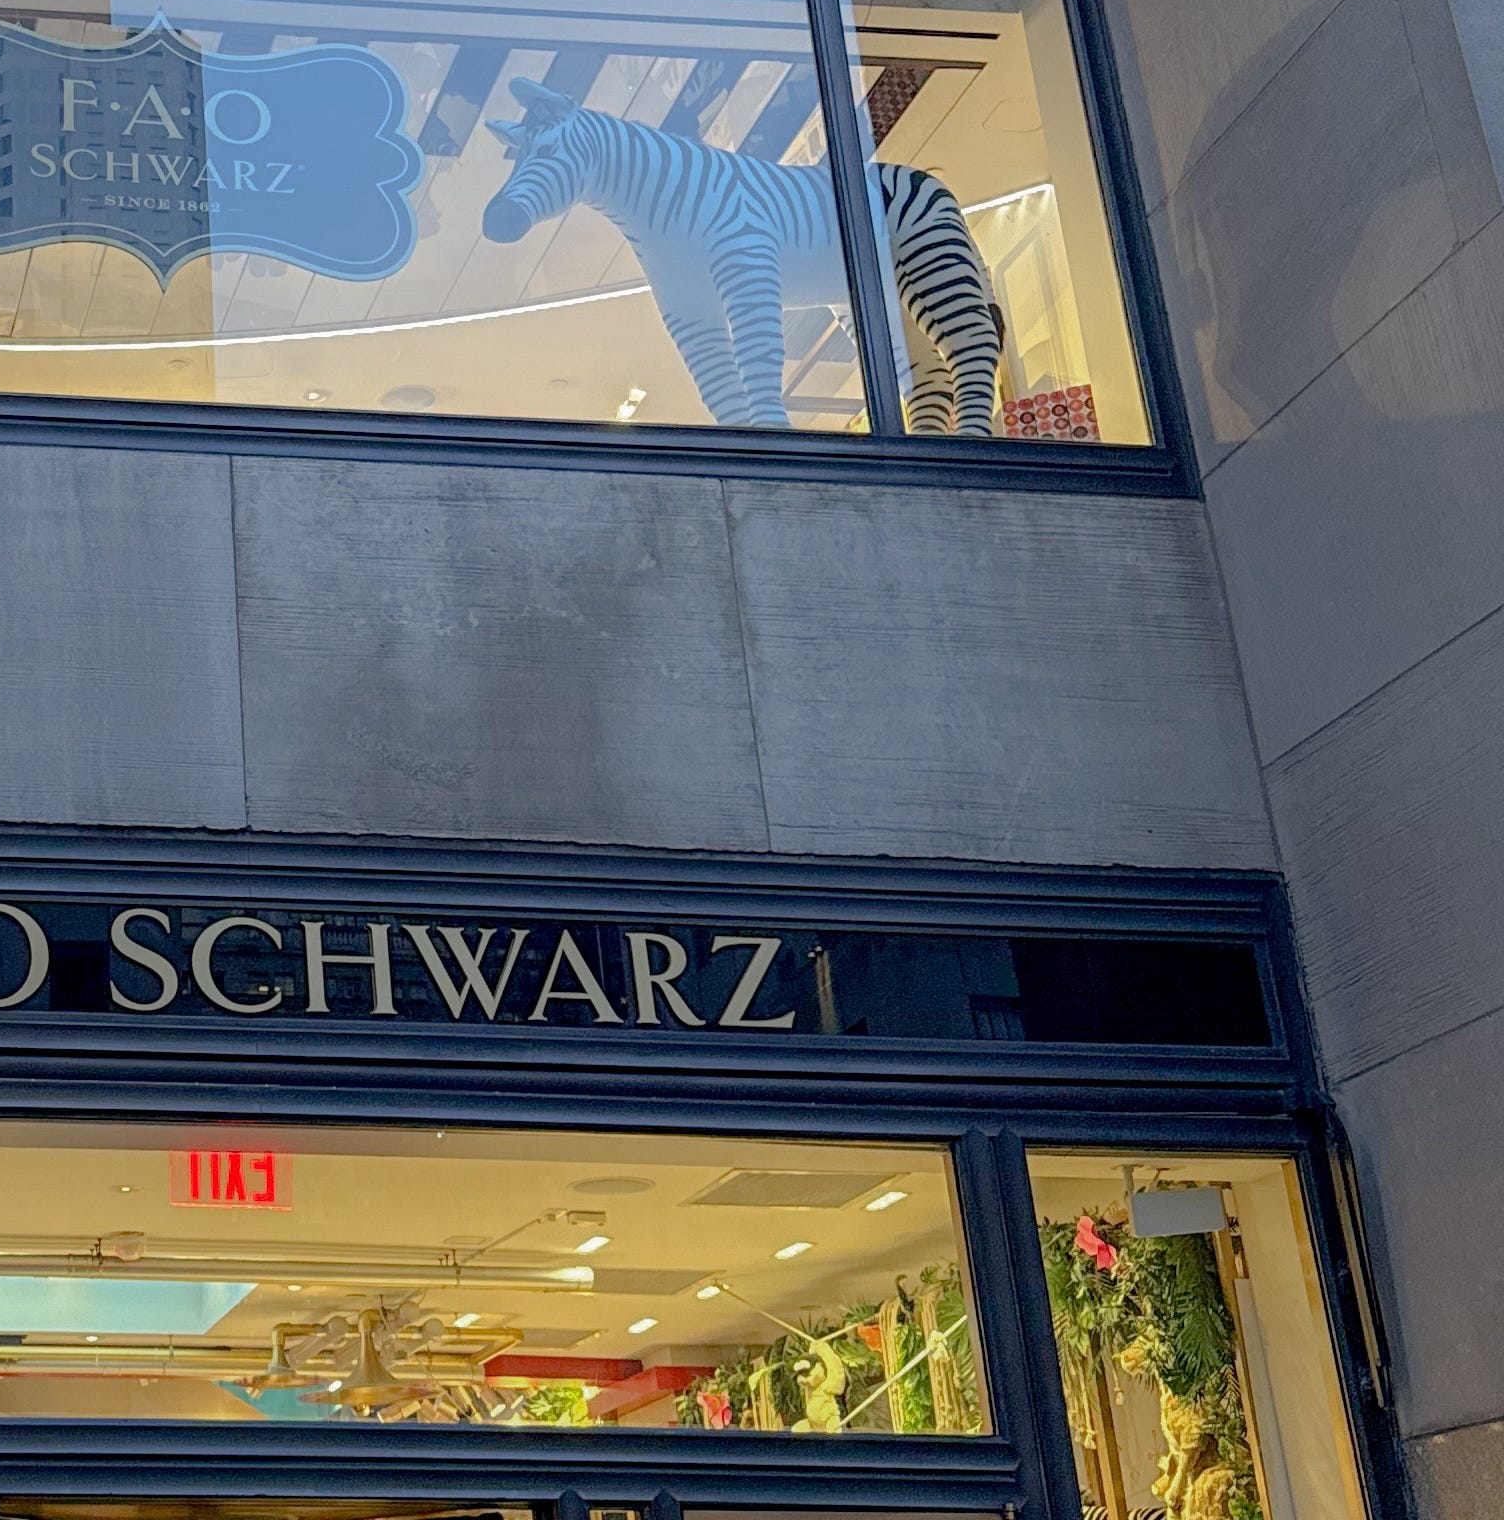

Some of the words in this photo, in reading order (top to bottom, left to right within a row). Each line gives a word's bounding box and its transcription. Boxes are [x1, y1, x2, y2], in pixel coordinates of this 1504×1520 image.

[29, 142, 297, 194] SCHWARZ
[104, 194, 171, 210] SINCE
[177, 198, 222, 214] 1862
[109, 907, 797, 1029] SCHWARZ
